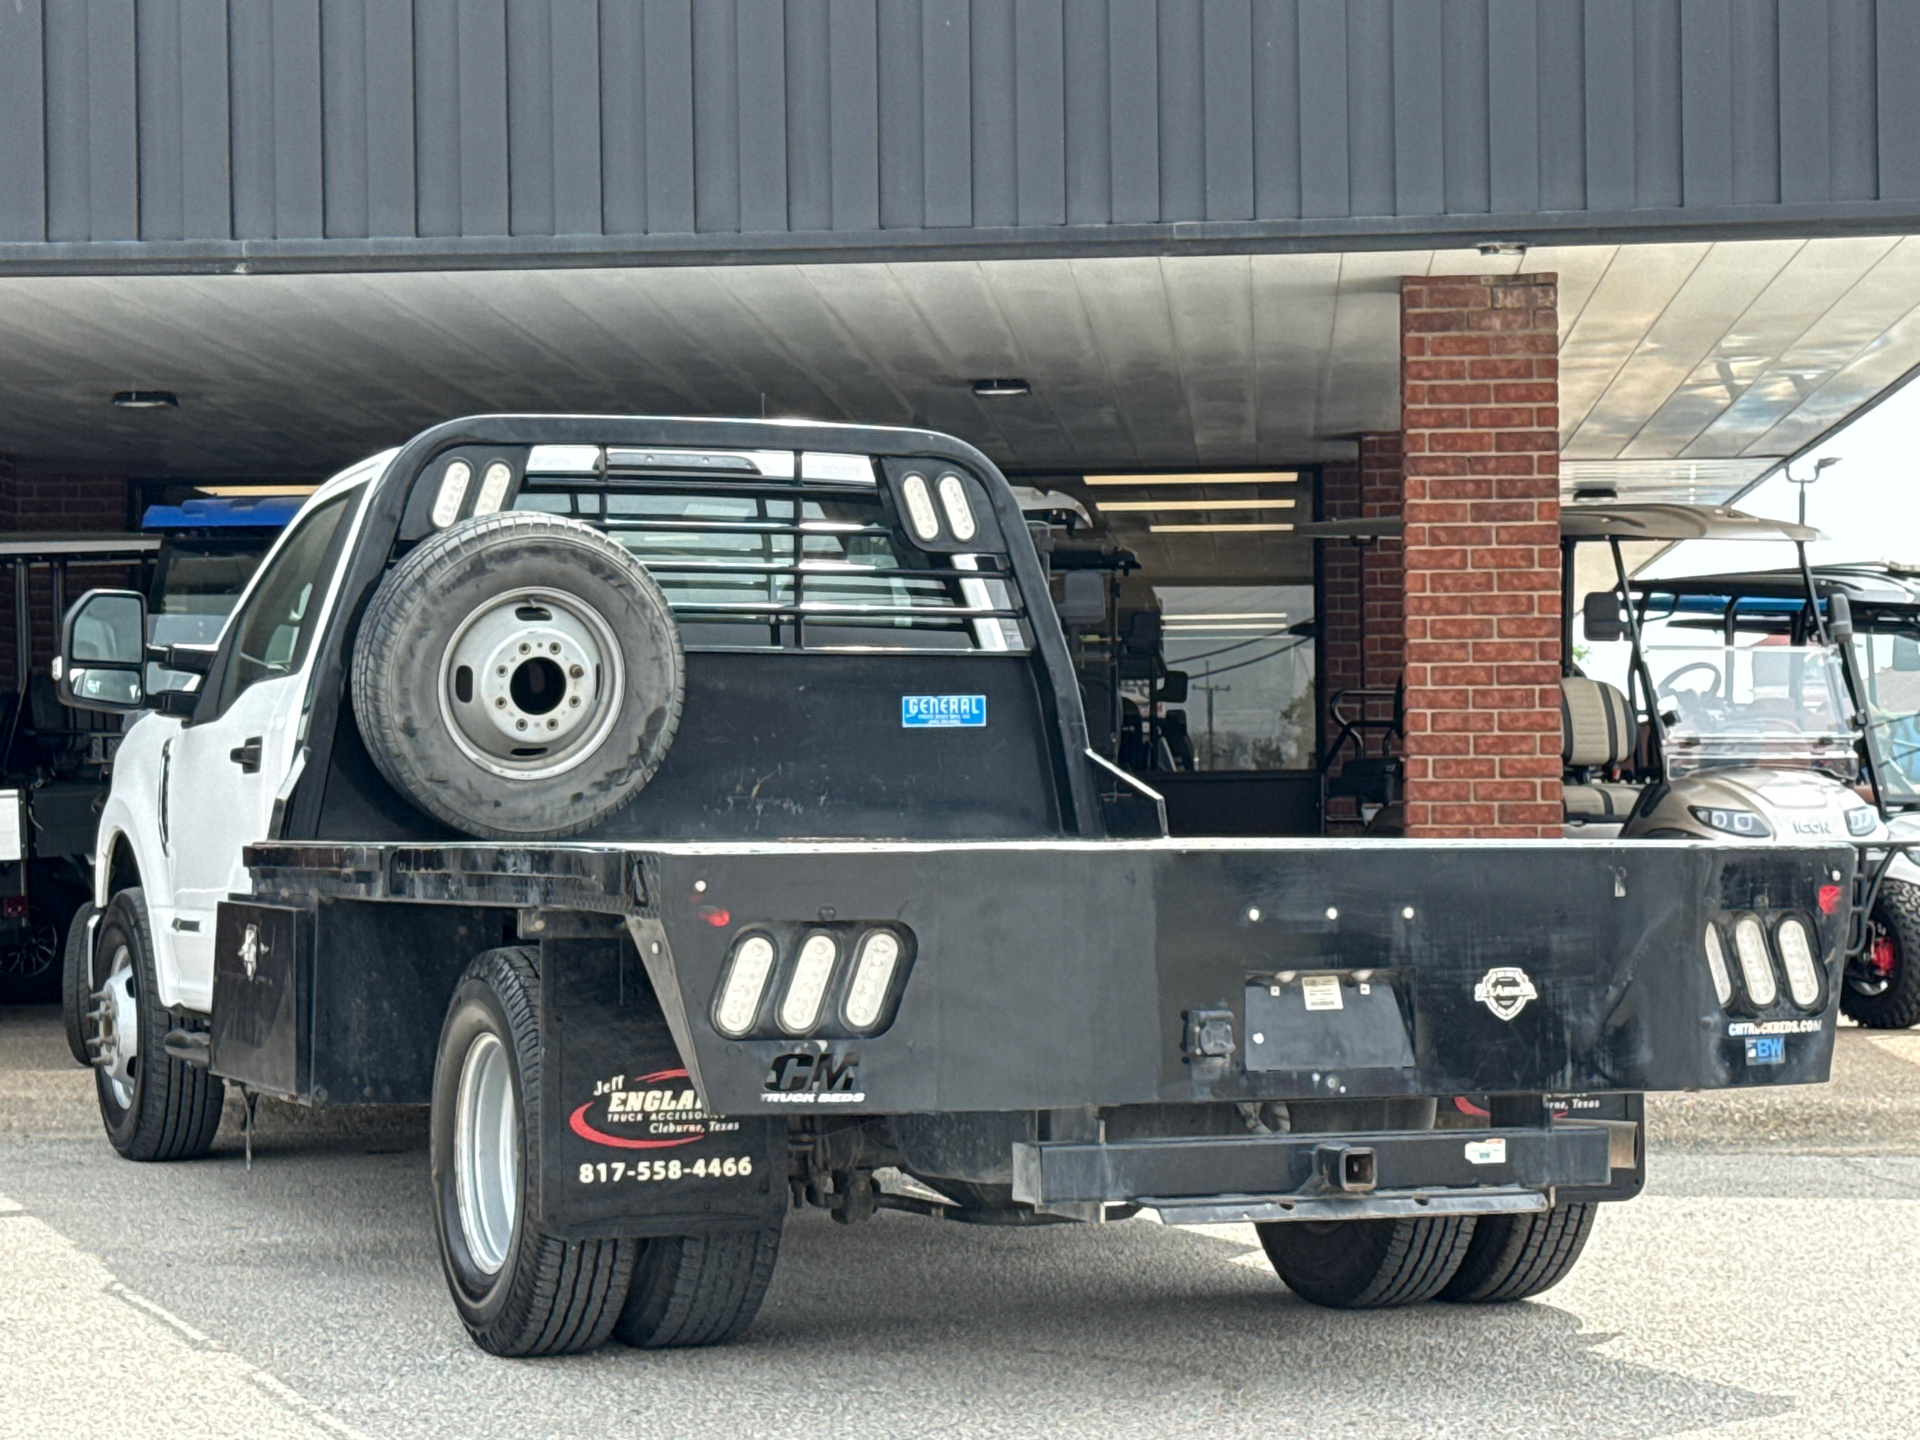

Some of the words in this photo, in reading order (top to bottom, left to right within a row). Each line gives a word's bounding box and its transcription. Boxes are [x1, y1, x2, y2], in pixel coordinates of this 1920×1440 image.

[909, 698, 980, 714] GENERAL
[1793, 821, 1832, 835] ICON
[764, 1053, 860, 1092] CM
[593, 1074, 625, 1096] Jeff
[608, 1090, 702, 1112] ENGLA
[761, 1093, 816, 1103] TRUCK
[818, 1093, 866, 1103] BEDS
[1572, 1098, 1600, 1110] Texas
[607, 1113, 643, 1122] TRUCK
[649, 1122, 705, 1134] Cleburne,
[708, 1120, 739, 1132] Texas
[578, 1156, 752, 1184] 817-558-4466
